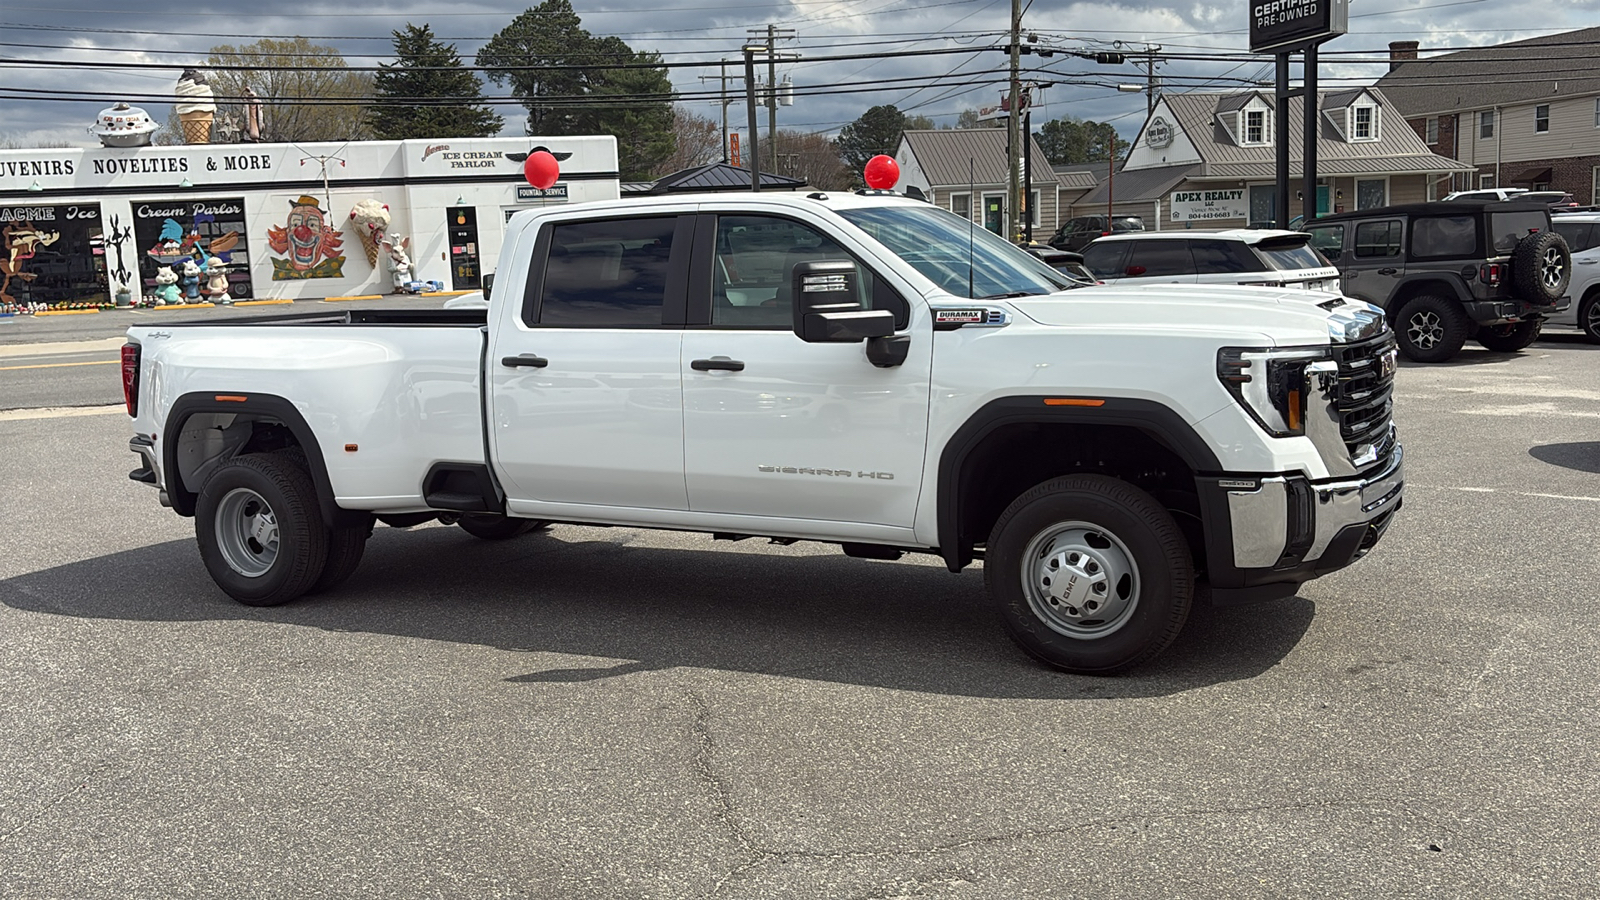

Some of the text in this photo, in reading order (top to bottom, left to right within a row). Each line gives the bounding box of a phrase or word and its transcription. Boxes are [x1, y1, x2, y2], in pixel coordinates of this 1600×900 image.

[1255, 0, 1317, 17] CERTIF
[1257, 3, 1317, 28] PRE-OWNED
[451, 160, 496, 168] PARLOR
[463, 152, 502, 160] CREAM
[93, 157, 189, 174] NOVELTIES
[206, 156, 218, 171] &
[224, 155, 271, 170] MORE
[1175, 191, 1243, 202] APEX REALTY
[0, 206, 98, 222] ACME Ice
[137, 203, 242, 218] Cream Parlor
[758, 464, 894, 480] SIERRA HD
[1063, 575, 1078, 599] GMC
